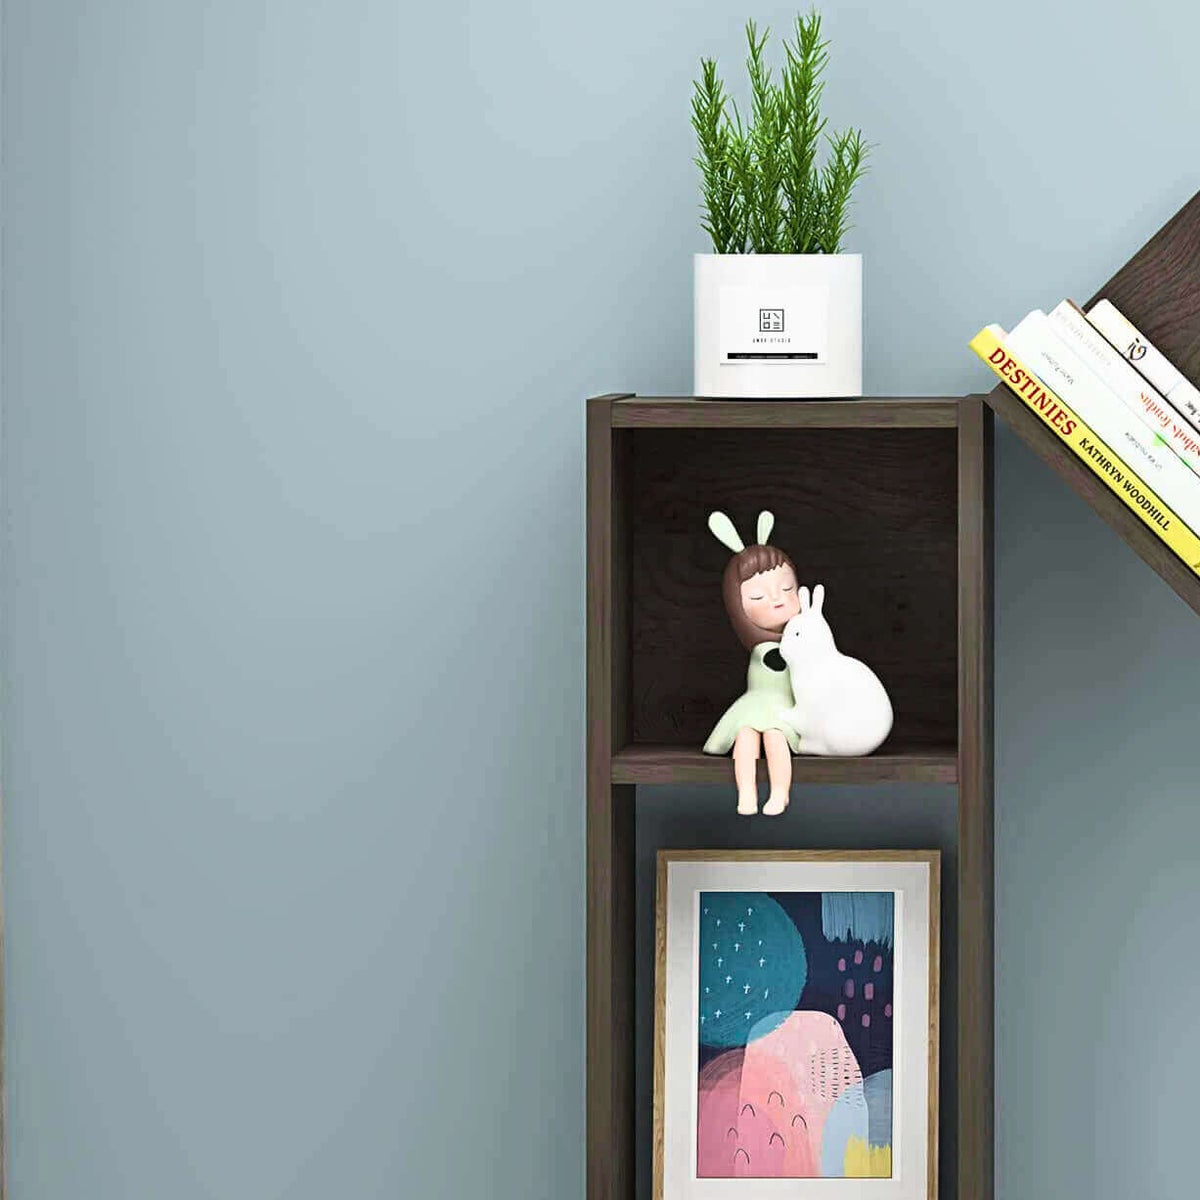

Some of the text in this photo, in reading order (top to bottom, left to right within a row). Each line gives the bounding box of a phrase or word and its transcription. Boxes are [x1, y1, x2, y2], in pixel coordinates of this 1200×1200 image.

[988, 347, 1078, 436] DESTINIES
[1079, 438, 1124, 483] KATHRYN
[1121, 480, 1171, 530] WOODHILL
